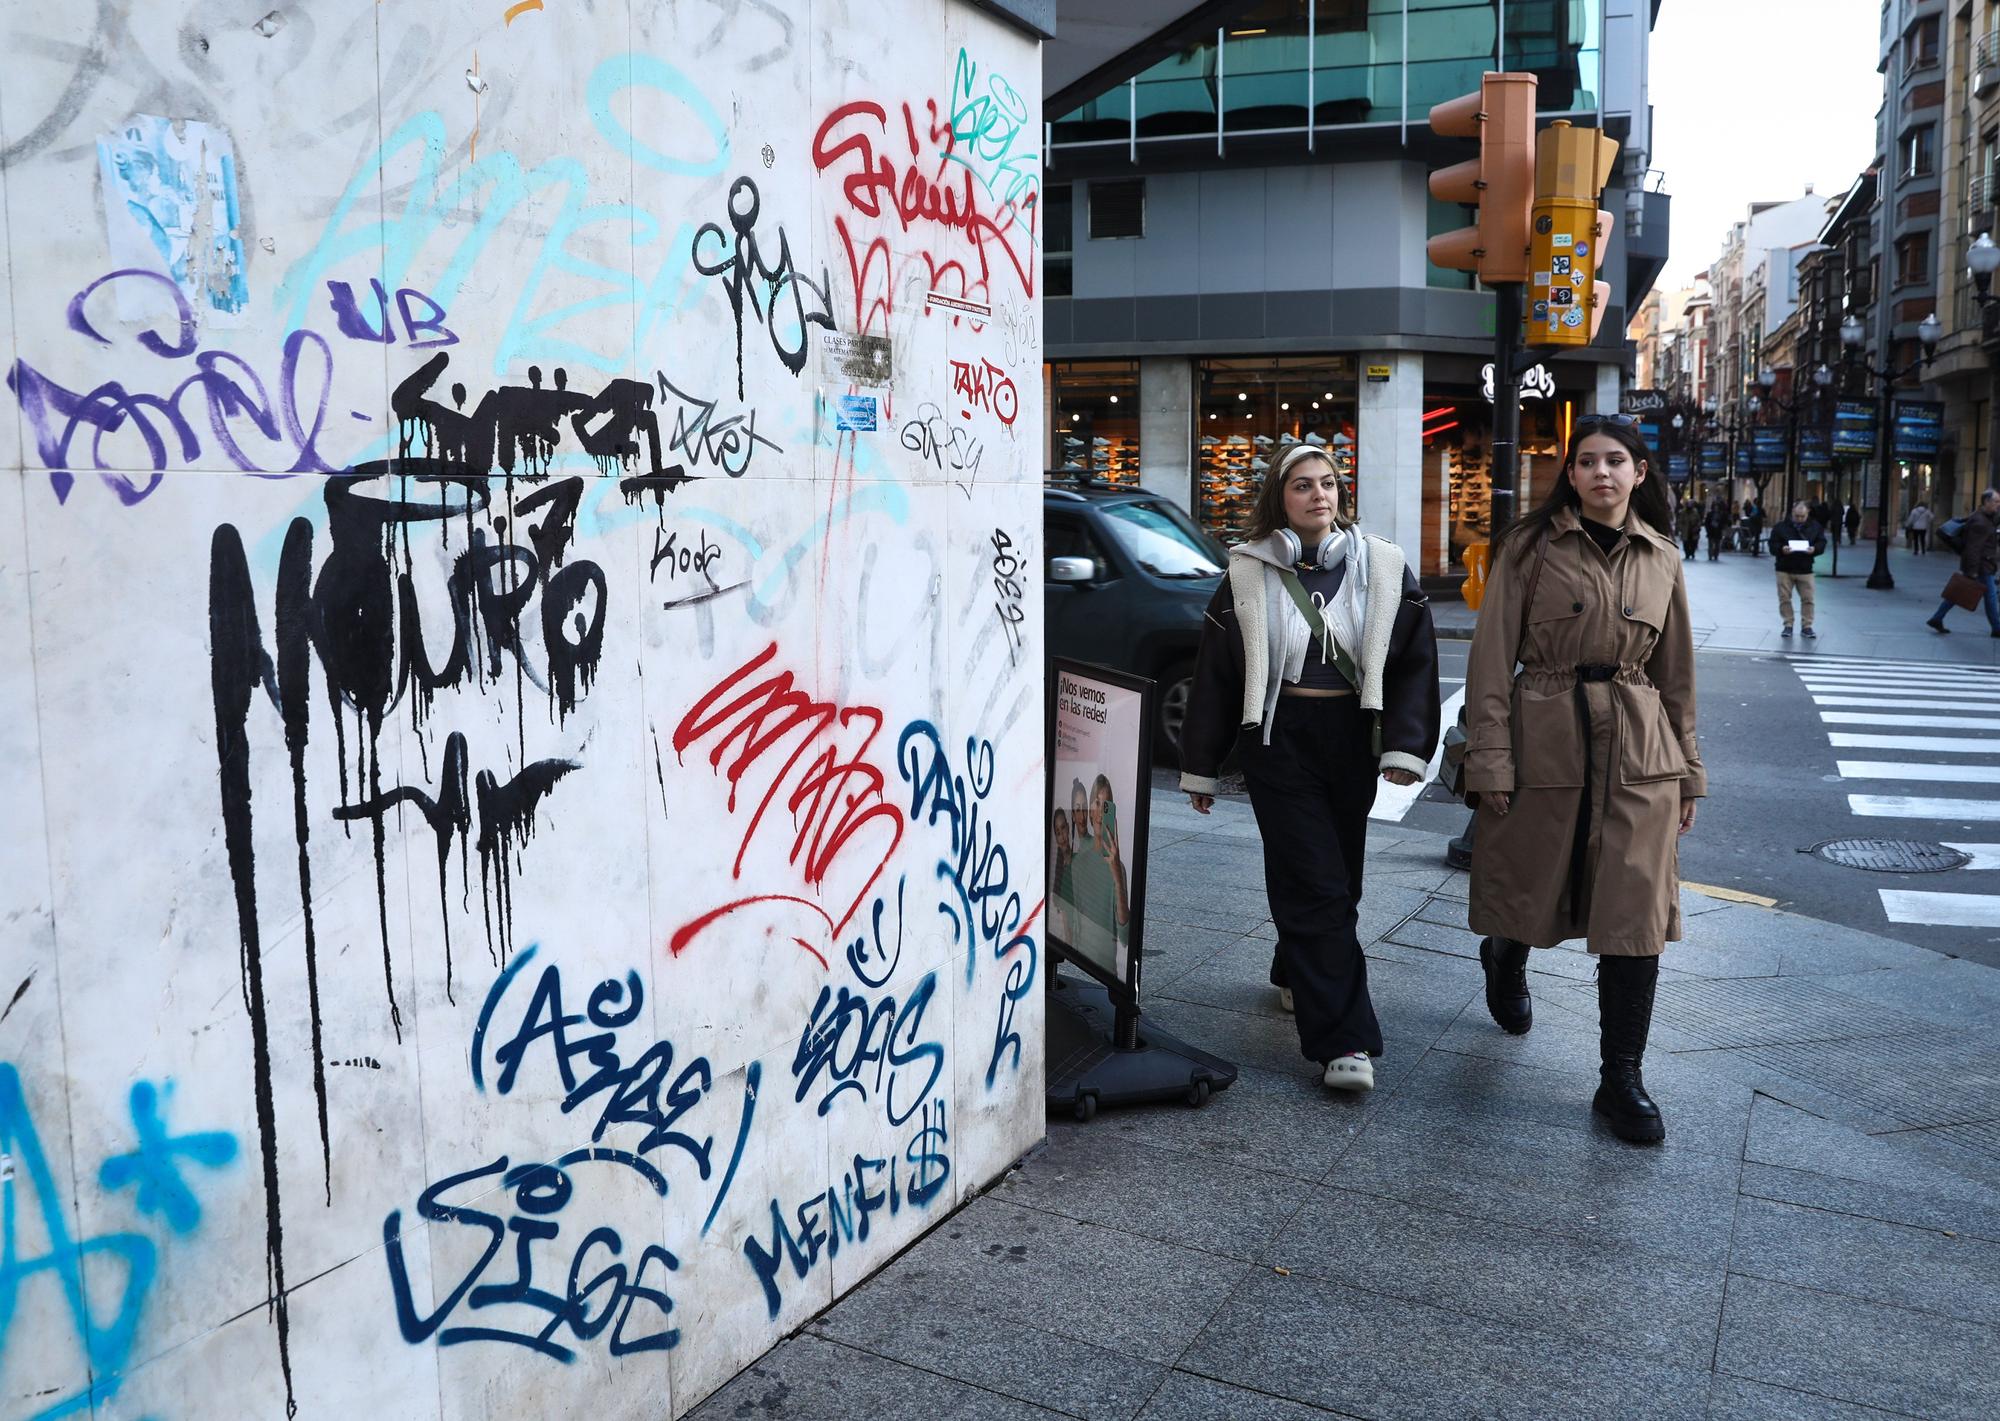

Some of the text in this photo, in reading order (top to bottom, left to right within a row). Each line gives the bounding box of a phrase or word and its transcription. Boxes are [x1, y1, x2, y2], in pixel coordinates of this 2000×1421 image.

[823, 335, 847, 346] CLASES
[1079, 684, 1106, 705] vemos
[1059, 696, 1108, 724] en las redes!
